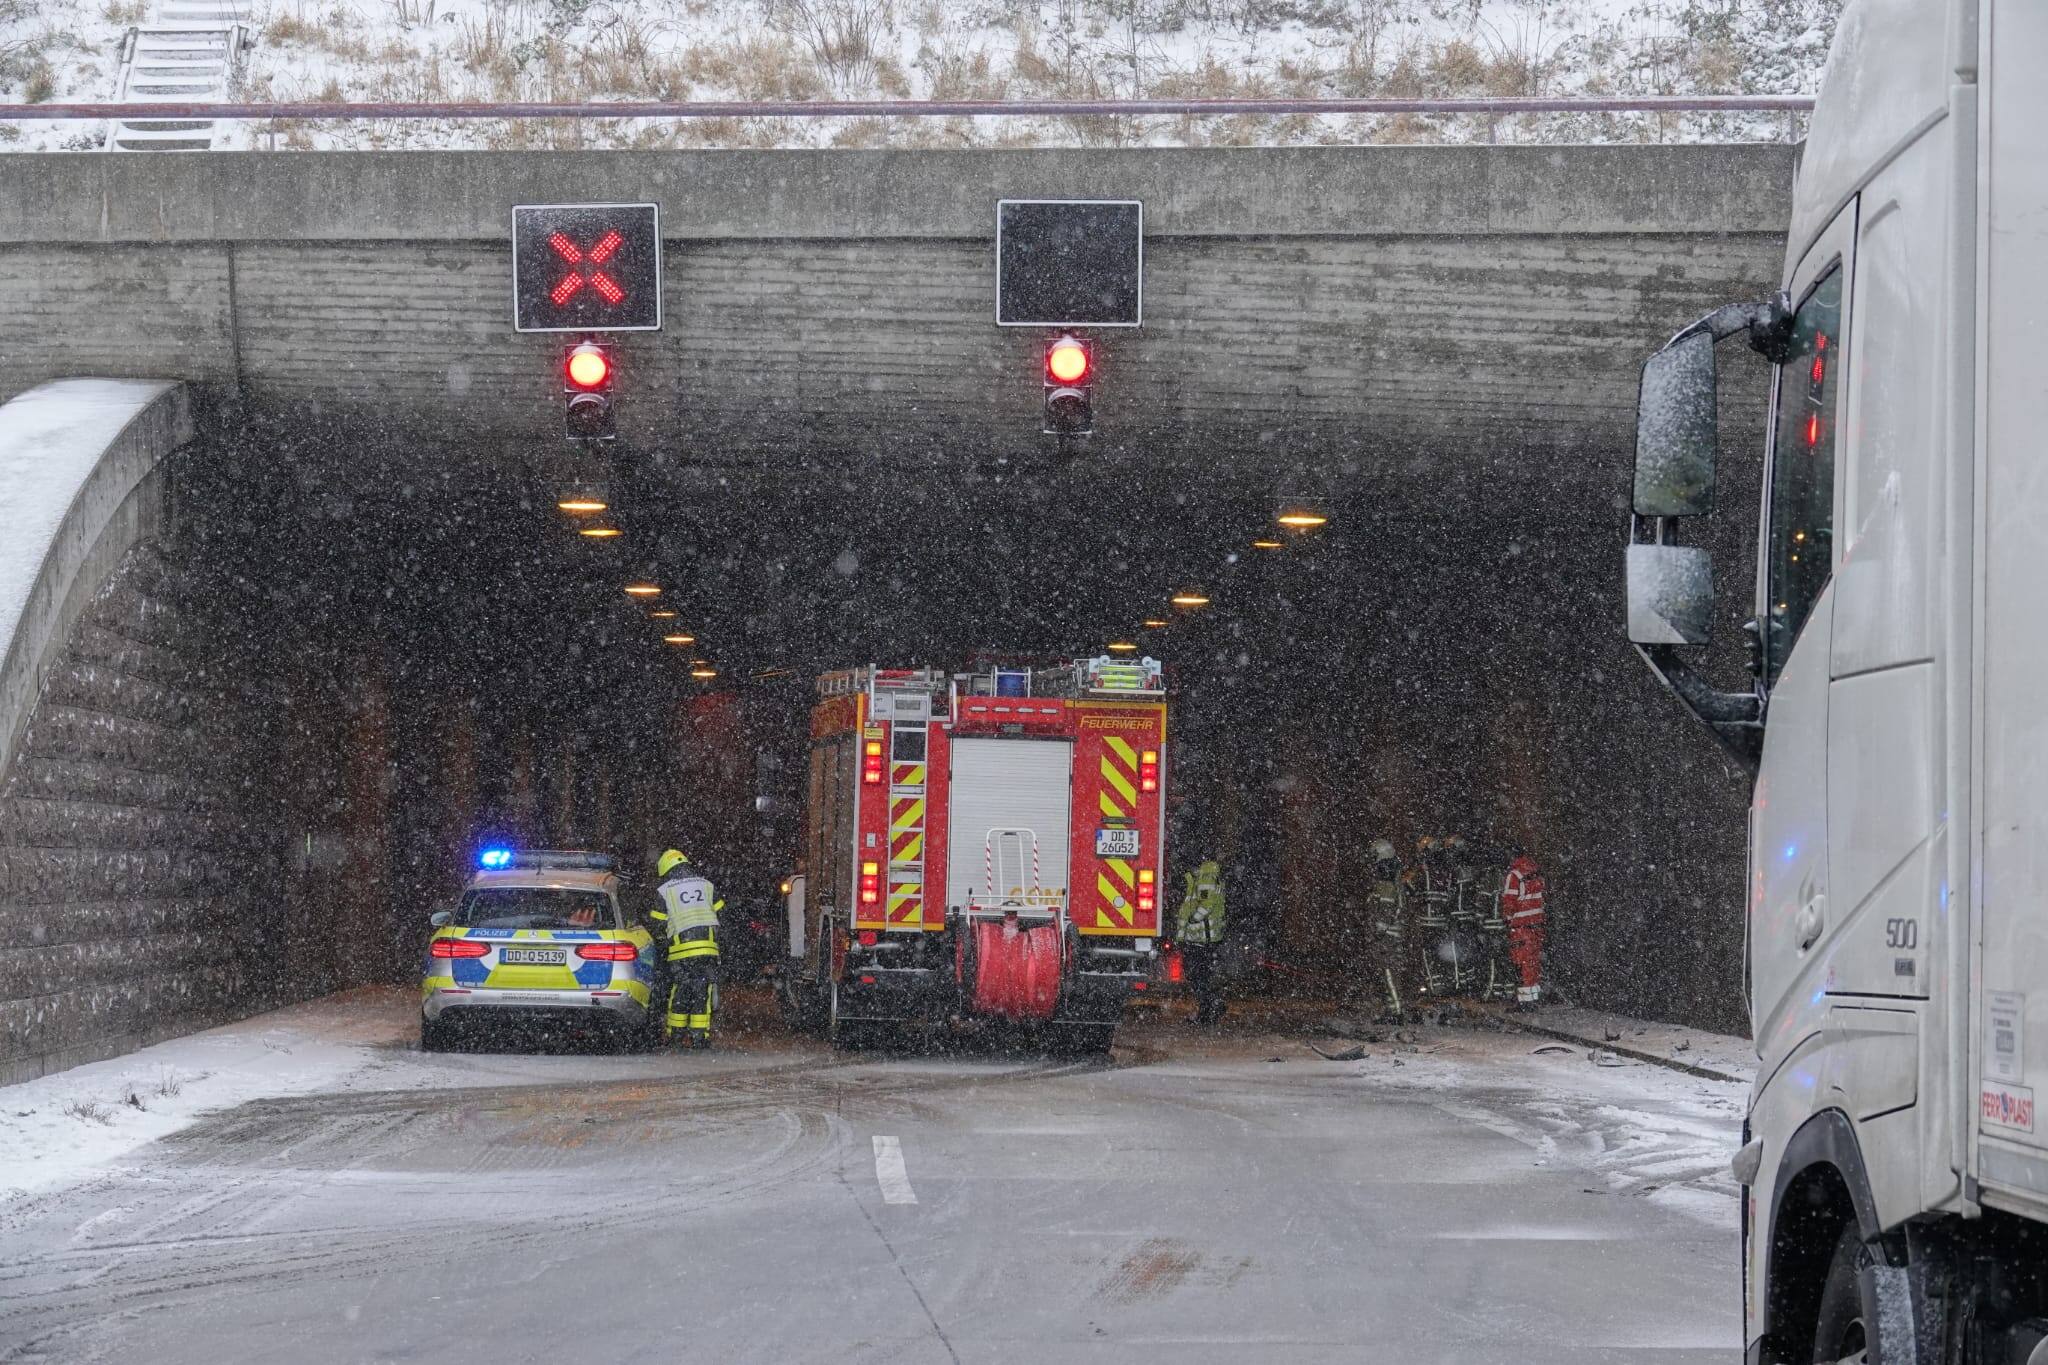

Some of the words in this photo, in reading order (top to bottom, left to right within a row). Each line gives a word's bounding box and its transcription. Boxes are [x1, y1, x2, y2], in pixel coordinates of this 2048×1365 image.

[1080, 716, 1155, 730] FEUERWEHR
[1111, 831, 1125, 842] DD
[1102, 842, 1135, 854] 26052
[679, 889, 705, 904] C-2
[474, 928, 509, 937] POLIZEI
[1886, 917, 1917, 949] 500
[507, 950, 522, 962] DD
[537, 951, 565, 963] 5139
